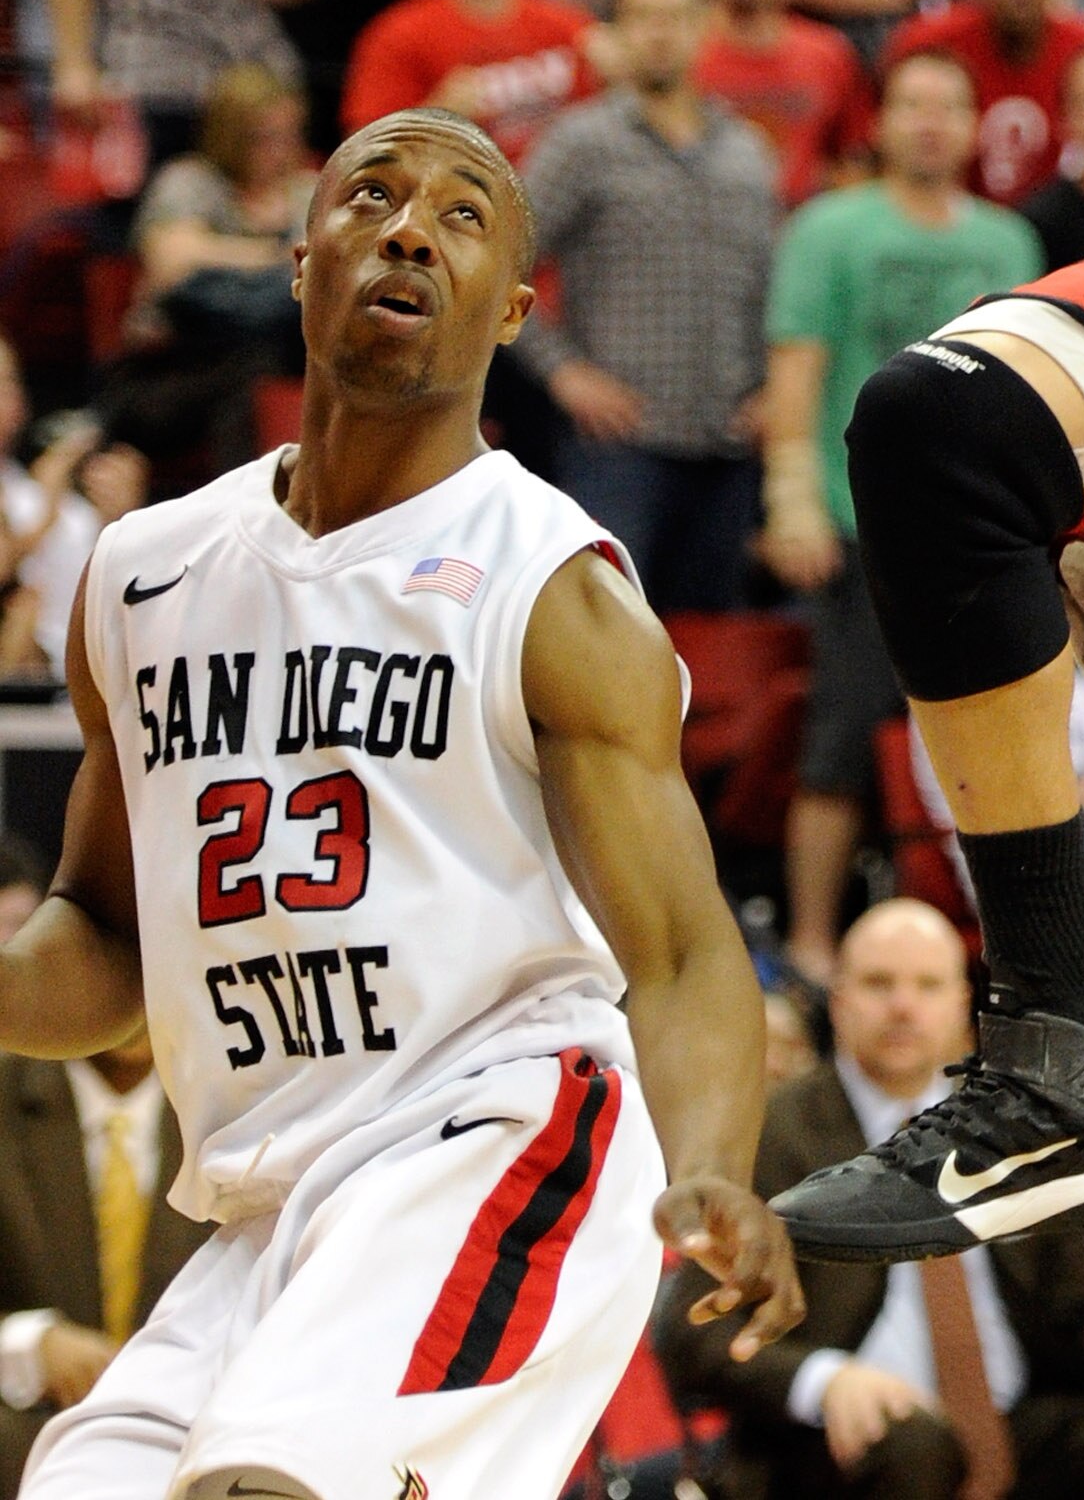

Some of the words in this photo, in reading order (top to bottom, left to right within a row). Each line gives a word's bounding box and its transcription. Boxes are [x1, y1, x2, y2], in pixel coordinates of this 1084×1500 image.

[135, 651, 256, 774] SAN
[275, 645, 455, 761] DIEGO
[196, 770, 371, 929] 23
[205, 945, 398, 1072] STATE
